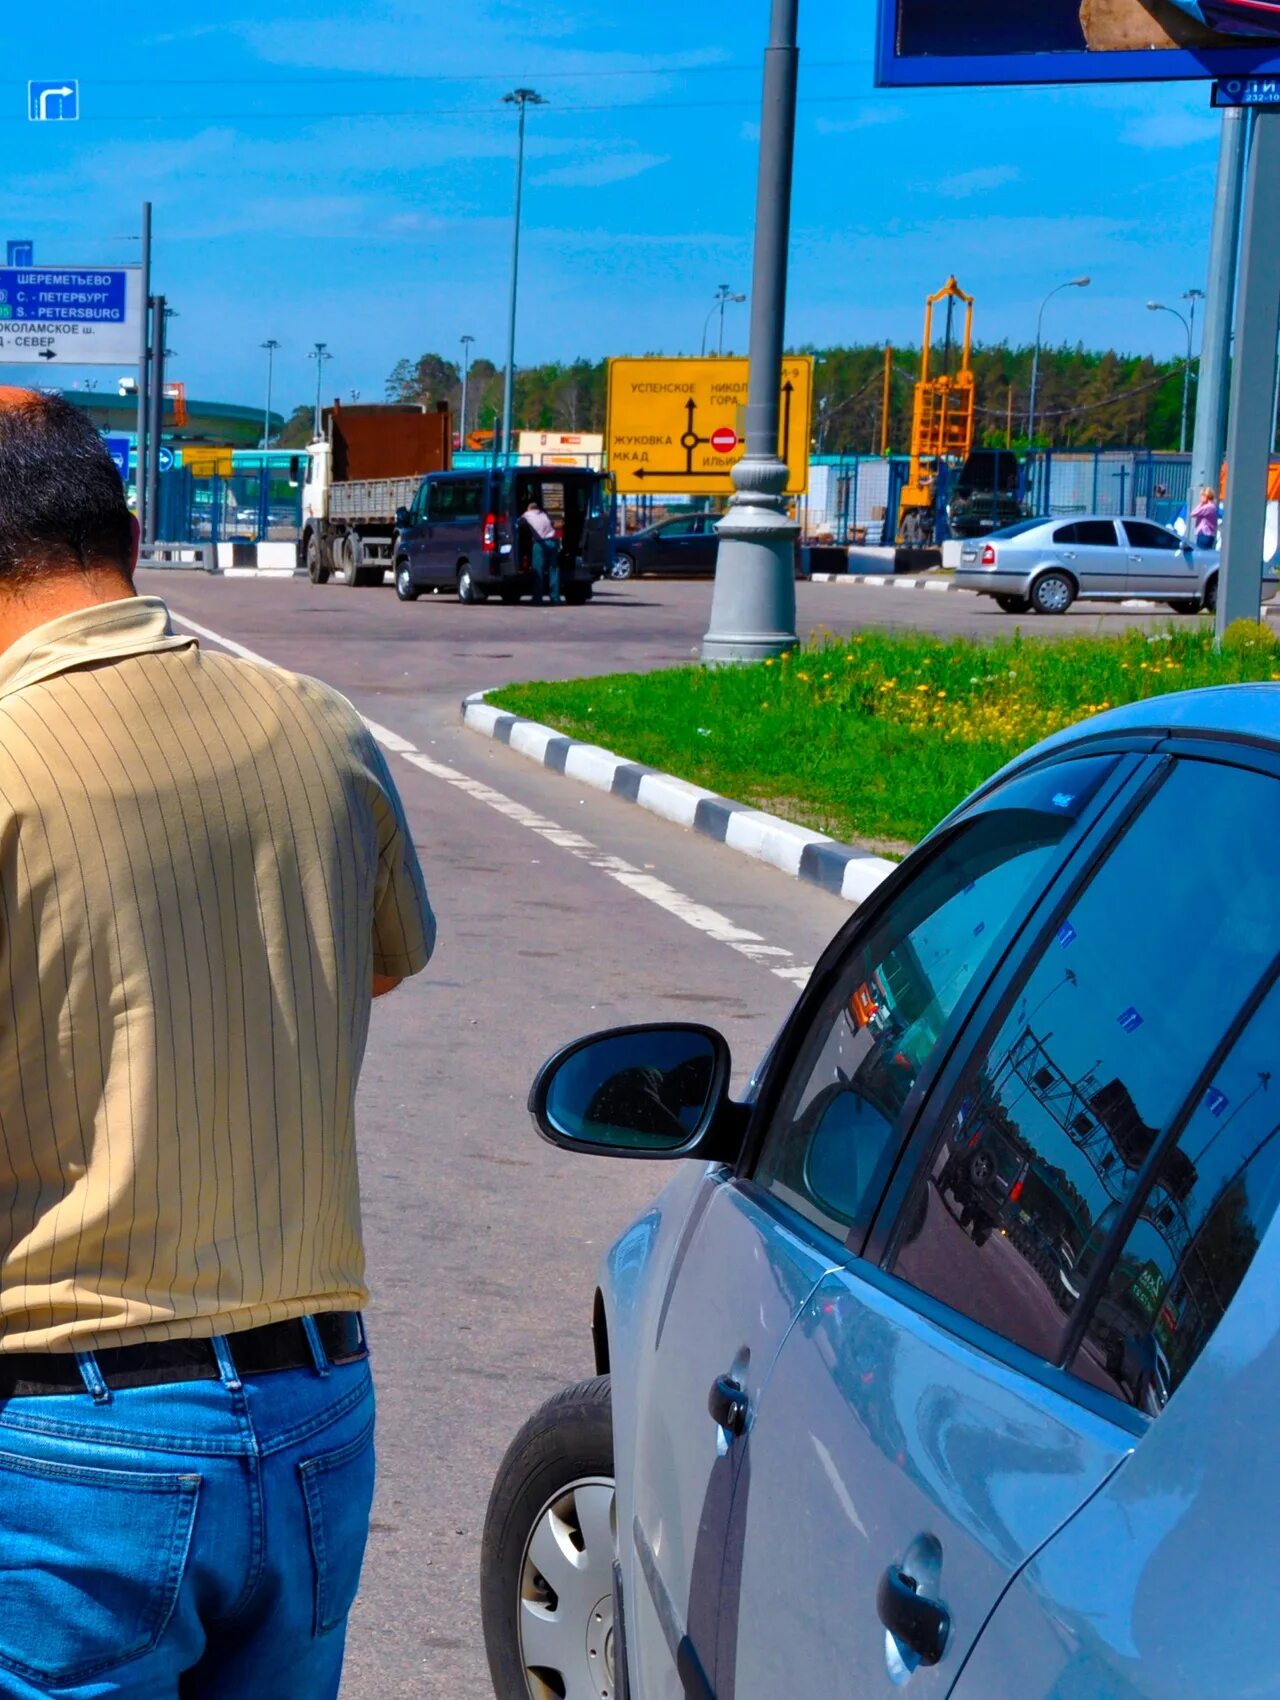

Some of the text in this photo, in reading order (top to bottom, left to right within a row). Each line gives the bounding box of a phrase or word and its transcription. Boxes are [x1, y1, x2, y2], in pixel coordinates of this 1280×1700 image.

[17, 274, 112, 286] ШЕРЕМЕТЬЕВО
[39, 292, 109, 303] ПЕТЕРБУРГ
[38, 307, 120, 319] PETERSBURG
[14, 337, 55, 347] СЕВЕР
[631, 383, 696, 393] УСПЕНСКОЕ
[710, 395, 738, 406] ГОРА
[614, 435, 673, 445] ЖУКОВКА
[613, 451, 649, 463] МКАД
